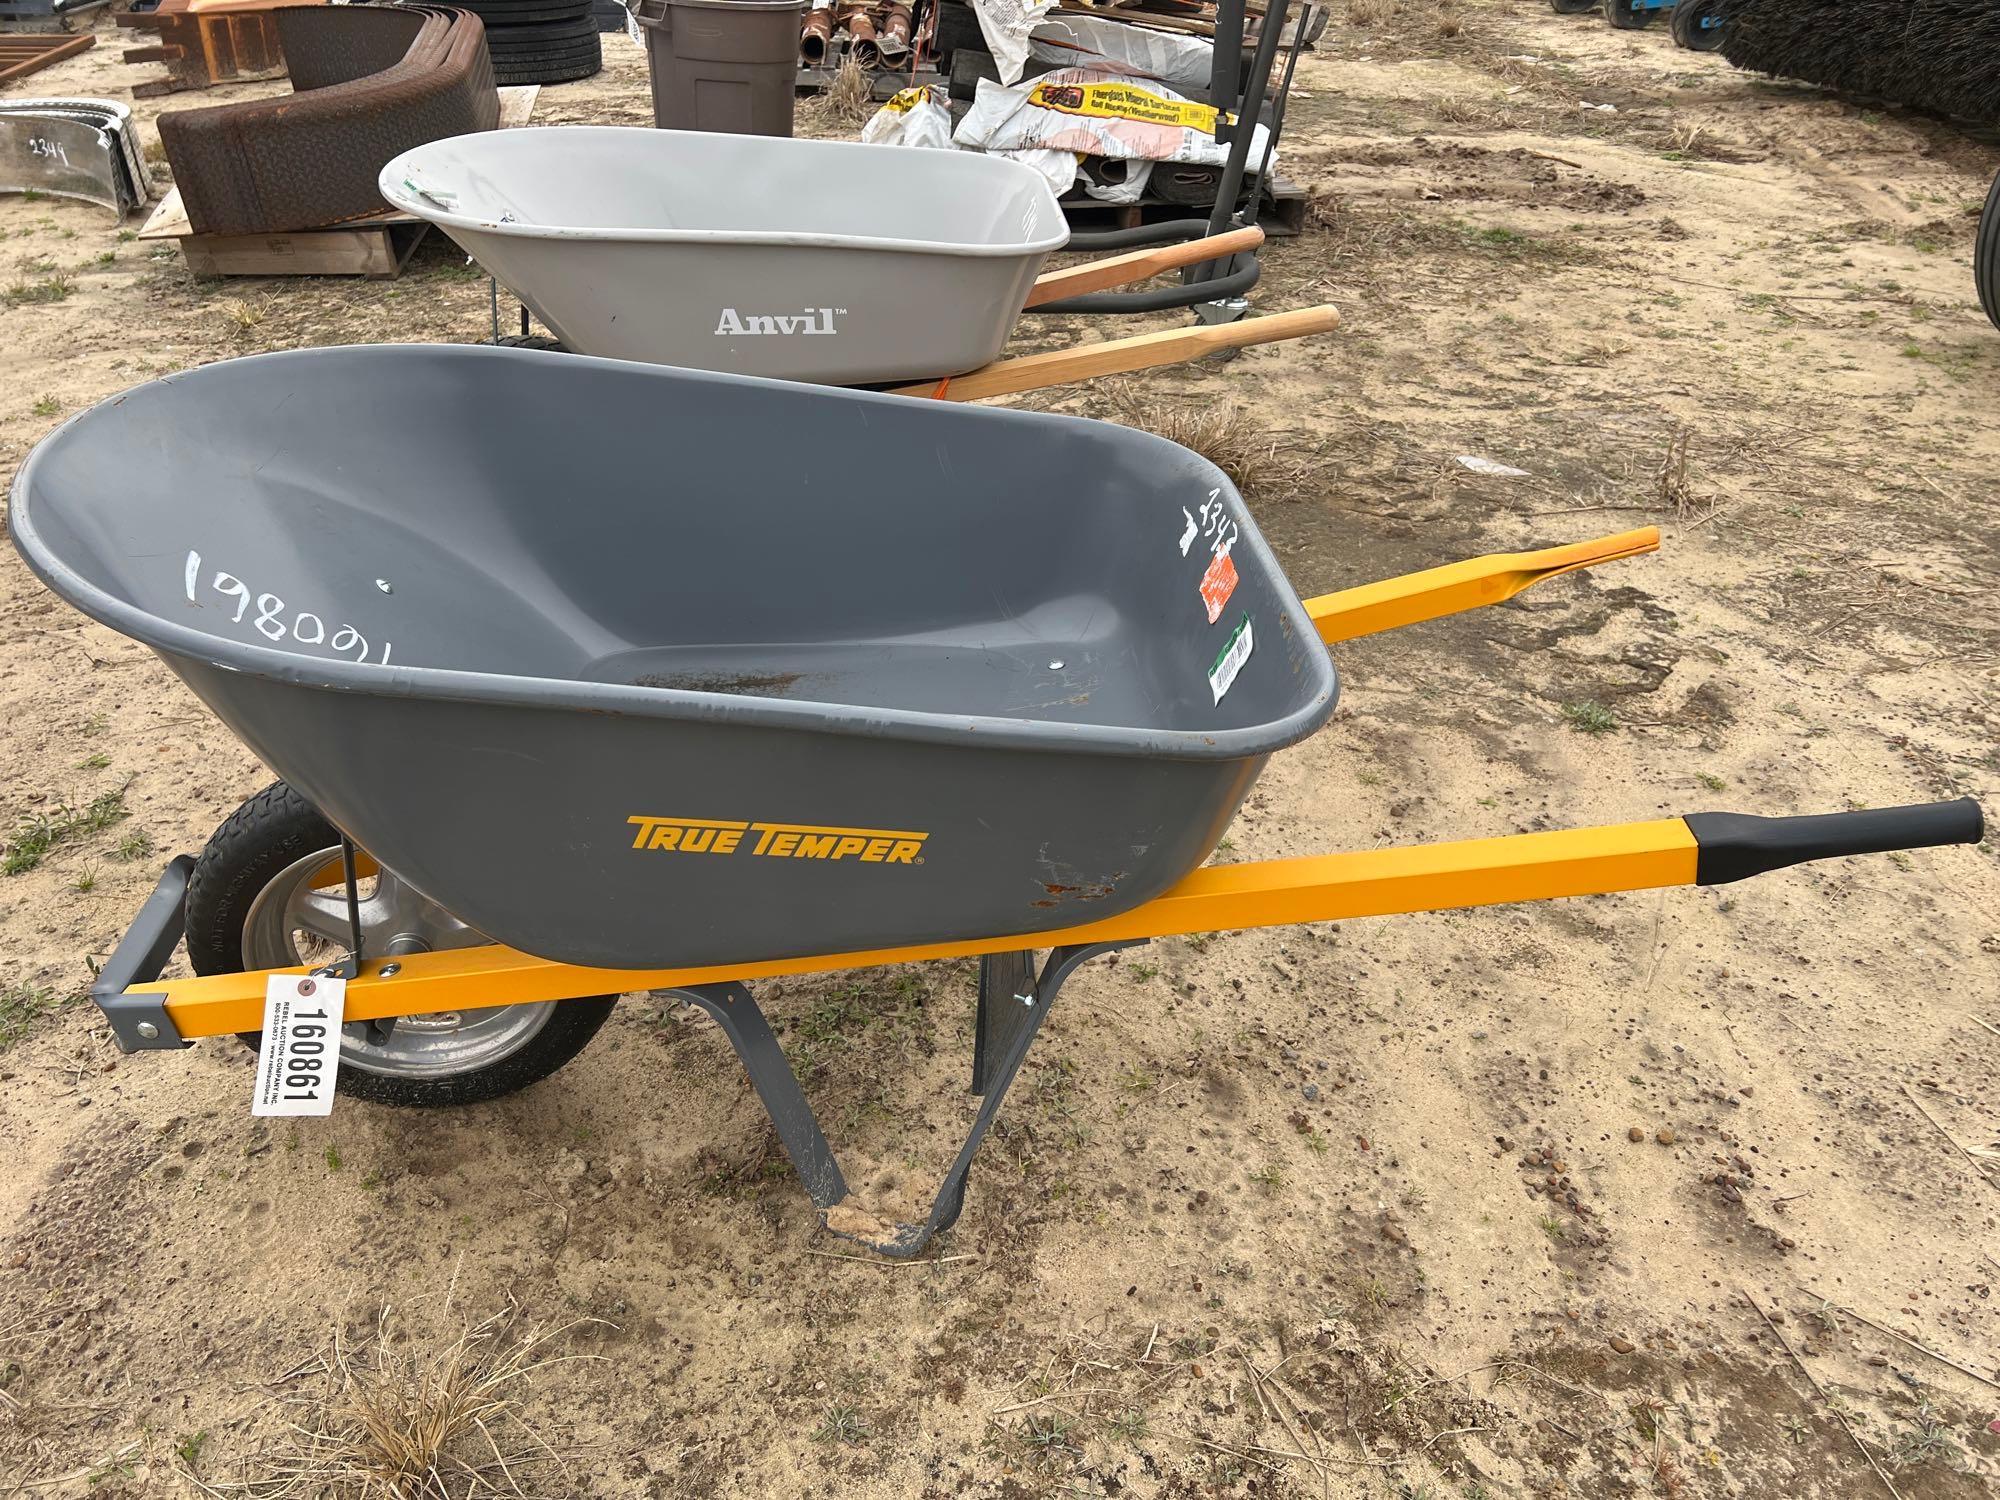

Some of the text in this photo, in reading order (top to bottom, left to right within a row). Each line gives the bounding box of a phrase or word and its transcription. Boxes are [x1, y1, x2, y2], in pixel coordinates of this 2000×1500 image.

[714, 308, 837, 335] Anvil
[627, 815, 930, 864] TRUE TEMPER
[281, 1001, 290, 1024] REBEL
[278, 1026, 287, 1056] AUCTION
[284, 1008, 328, 1100] 160861
[273, 1058, 283, 1092] COMPANY
